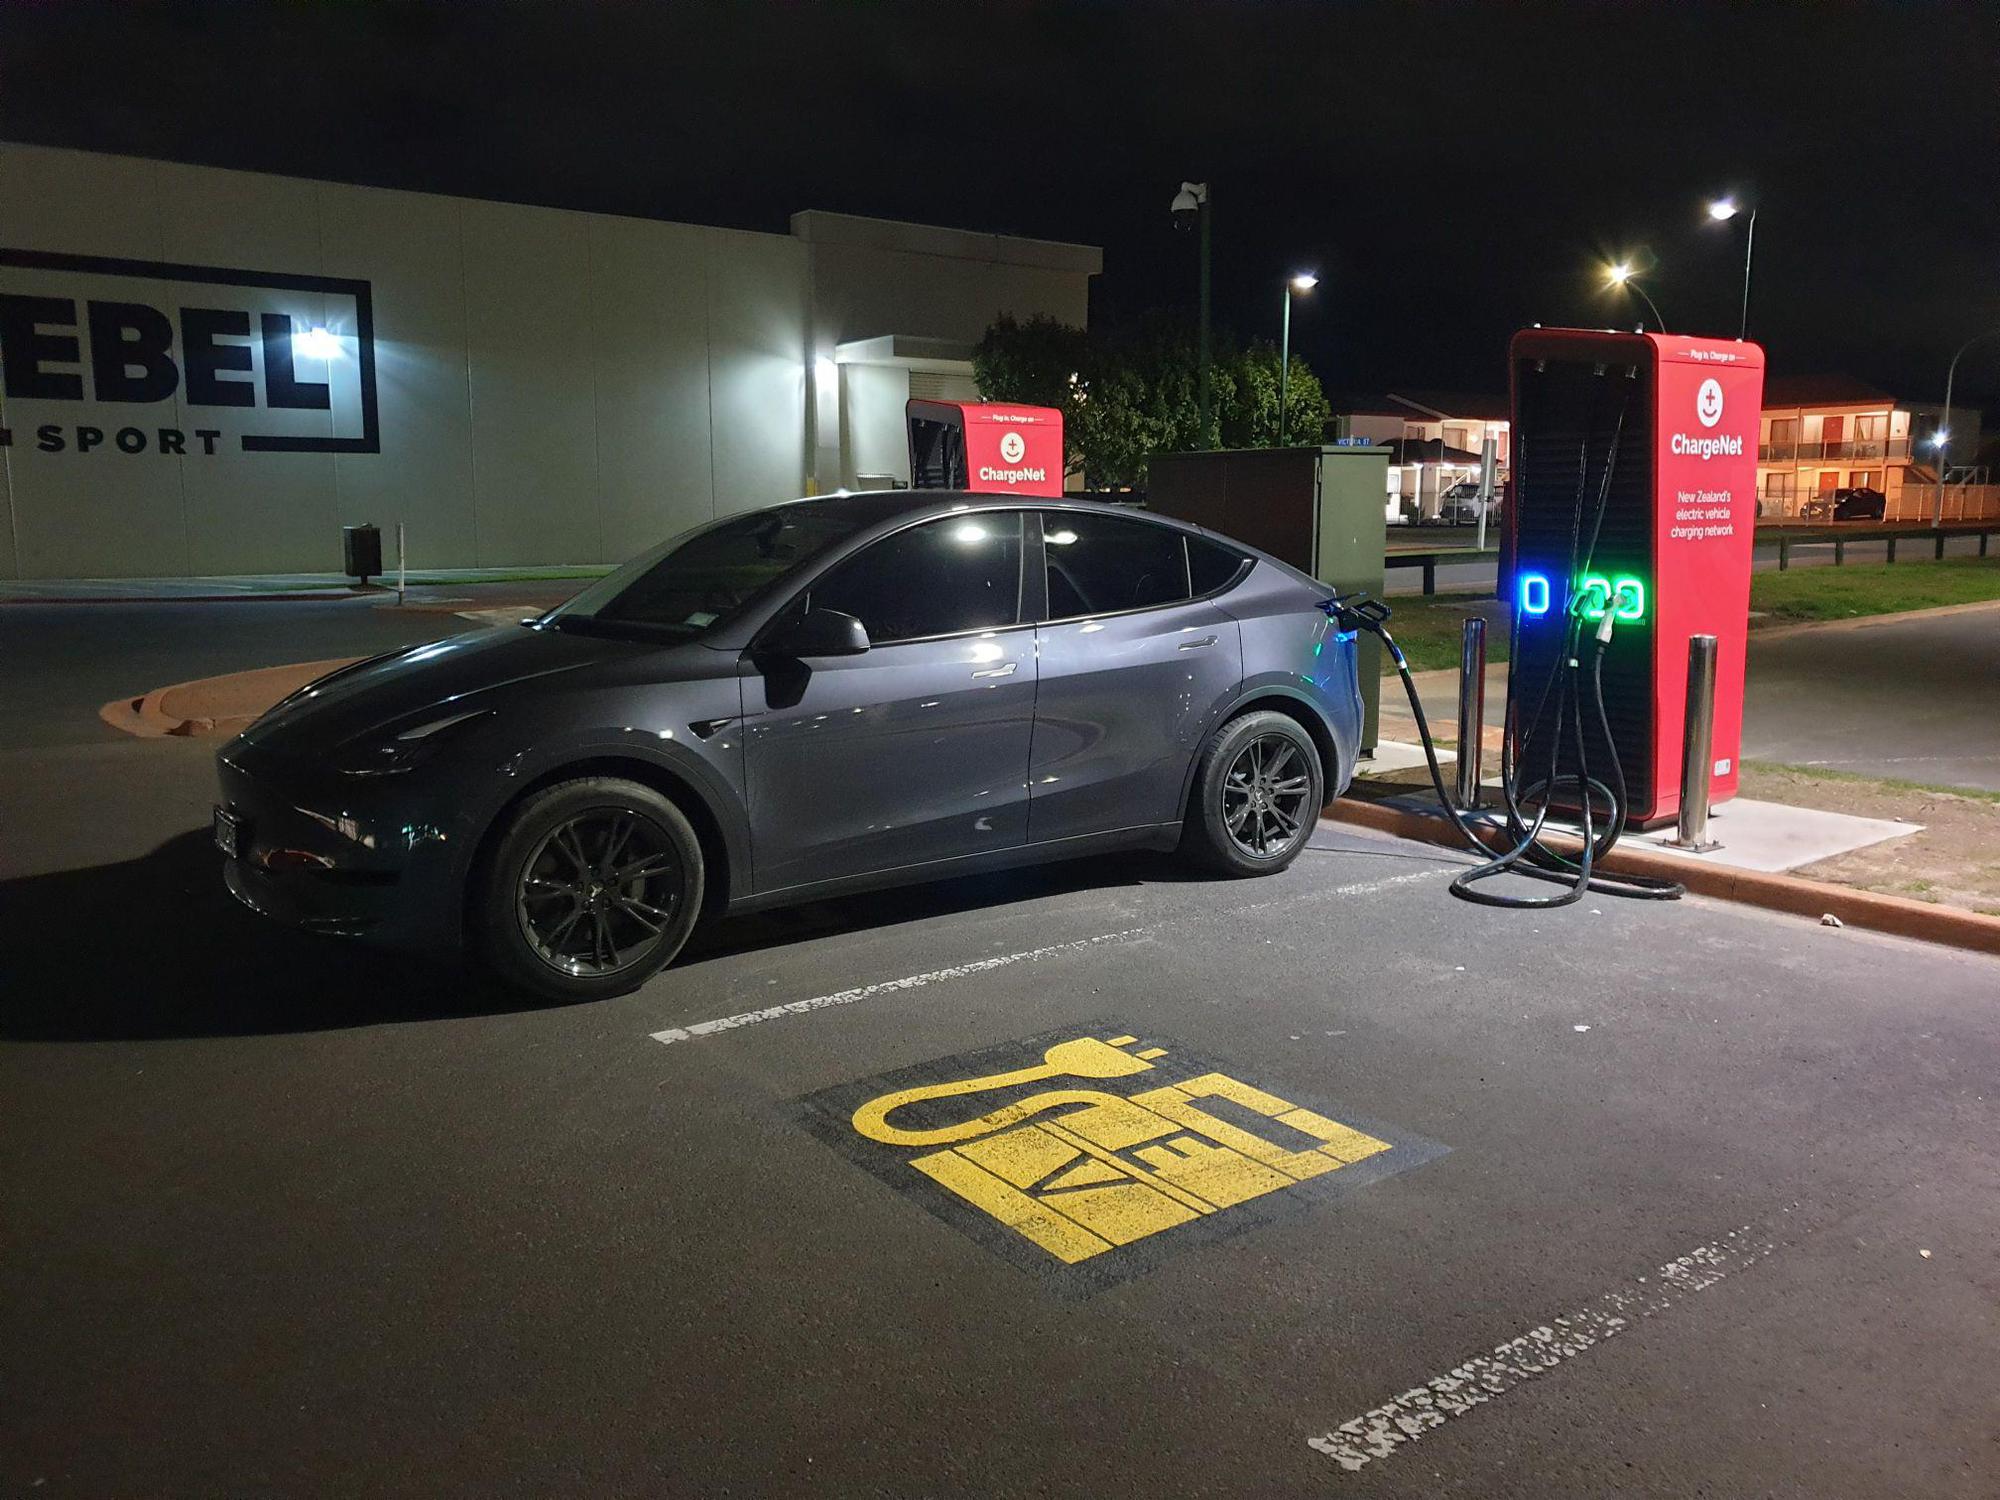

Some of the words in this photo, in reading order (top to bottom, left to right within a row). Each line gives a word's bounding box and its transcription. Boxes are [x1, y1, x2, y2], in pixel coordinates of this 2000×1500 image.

[36, 425, 221, 455] SPORT
[1363, 438, 1370, 446] ST
[1671, 433, 1743, 460] ChargeNet
[979, 466, 1046, 485] ChargeNet
[1678, 490, 1697, 504] New
[1696, 490, 1731, 504] Zealand's
[1676, 507, 1705, 521] electric
[1705, 506, 1731, 520] vehicle
[1670, 525, 1704, 541] charging
[1704, 523, 1734, 537] network
